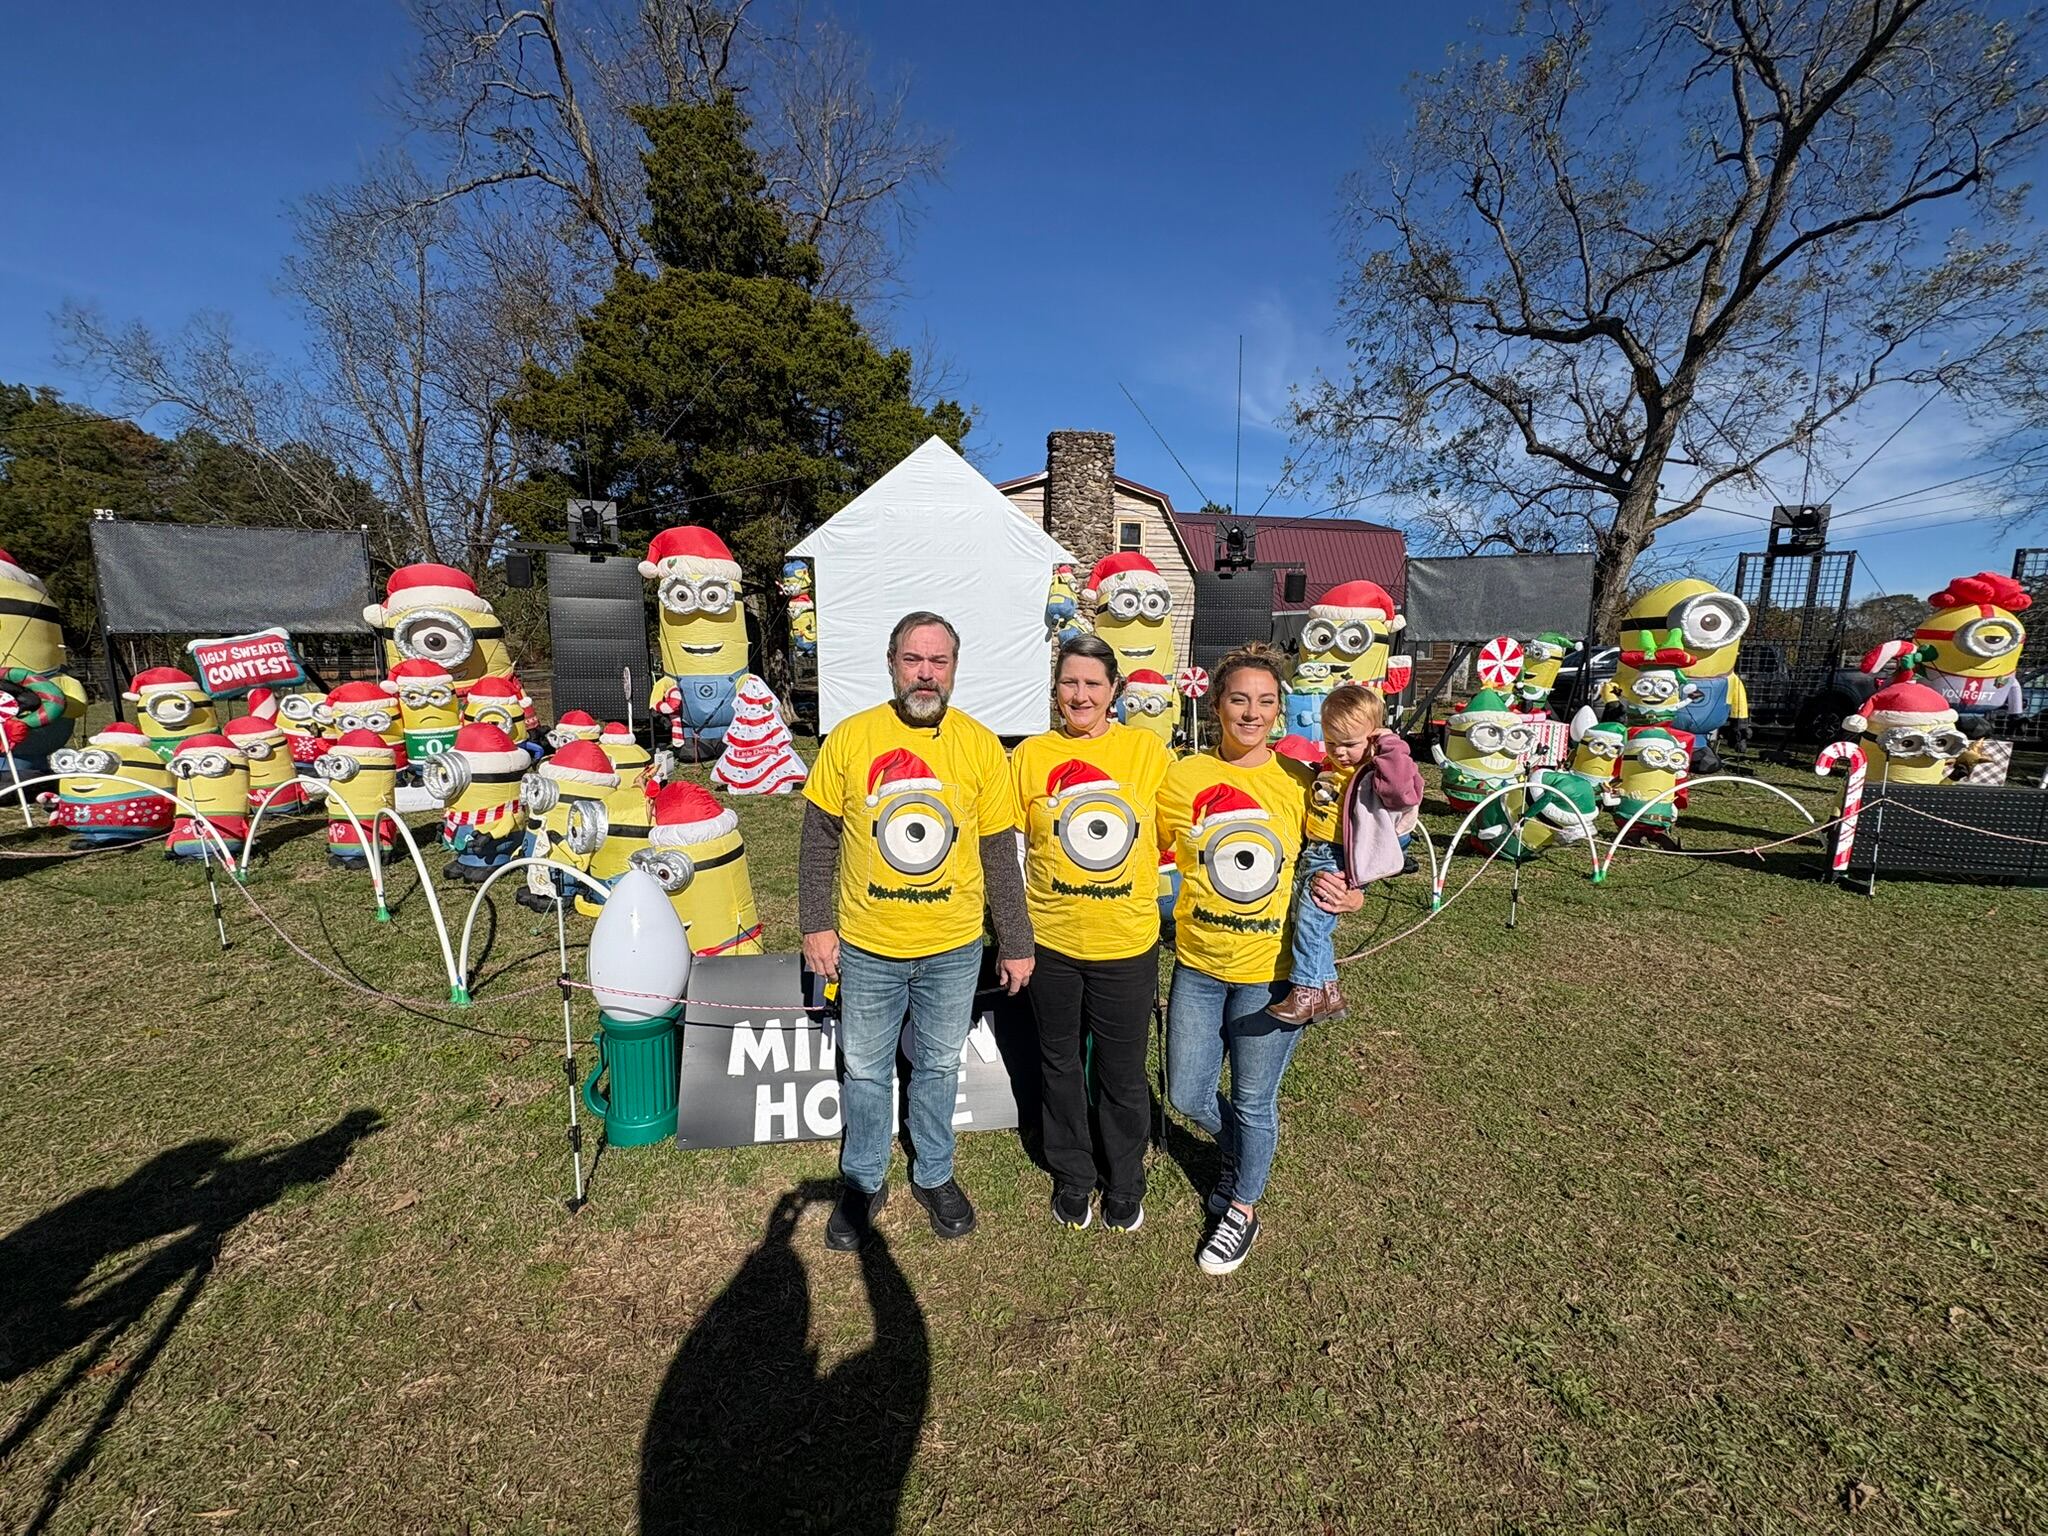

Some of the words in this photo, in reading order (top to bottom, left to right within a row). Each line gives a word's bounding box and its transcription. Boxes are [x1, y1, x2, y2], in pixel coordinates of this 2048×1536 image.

[199, 650, 228, 666] UGLY
[230, 642, 286, 659] SWEATER
[208, 655, 291, 685] CONTEST
[1941, 688, 1970, 700] YOUR
[1971, 690, 1995, 701] GIFT
[727, 1010, 998, 1076] MIN
